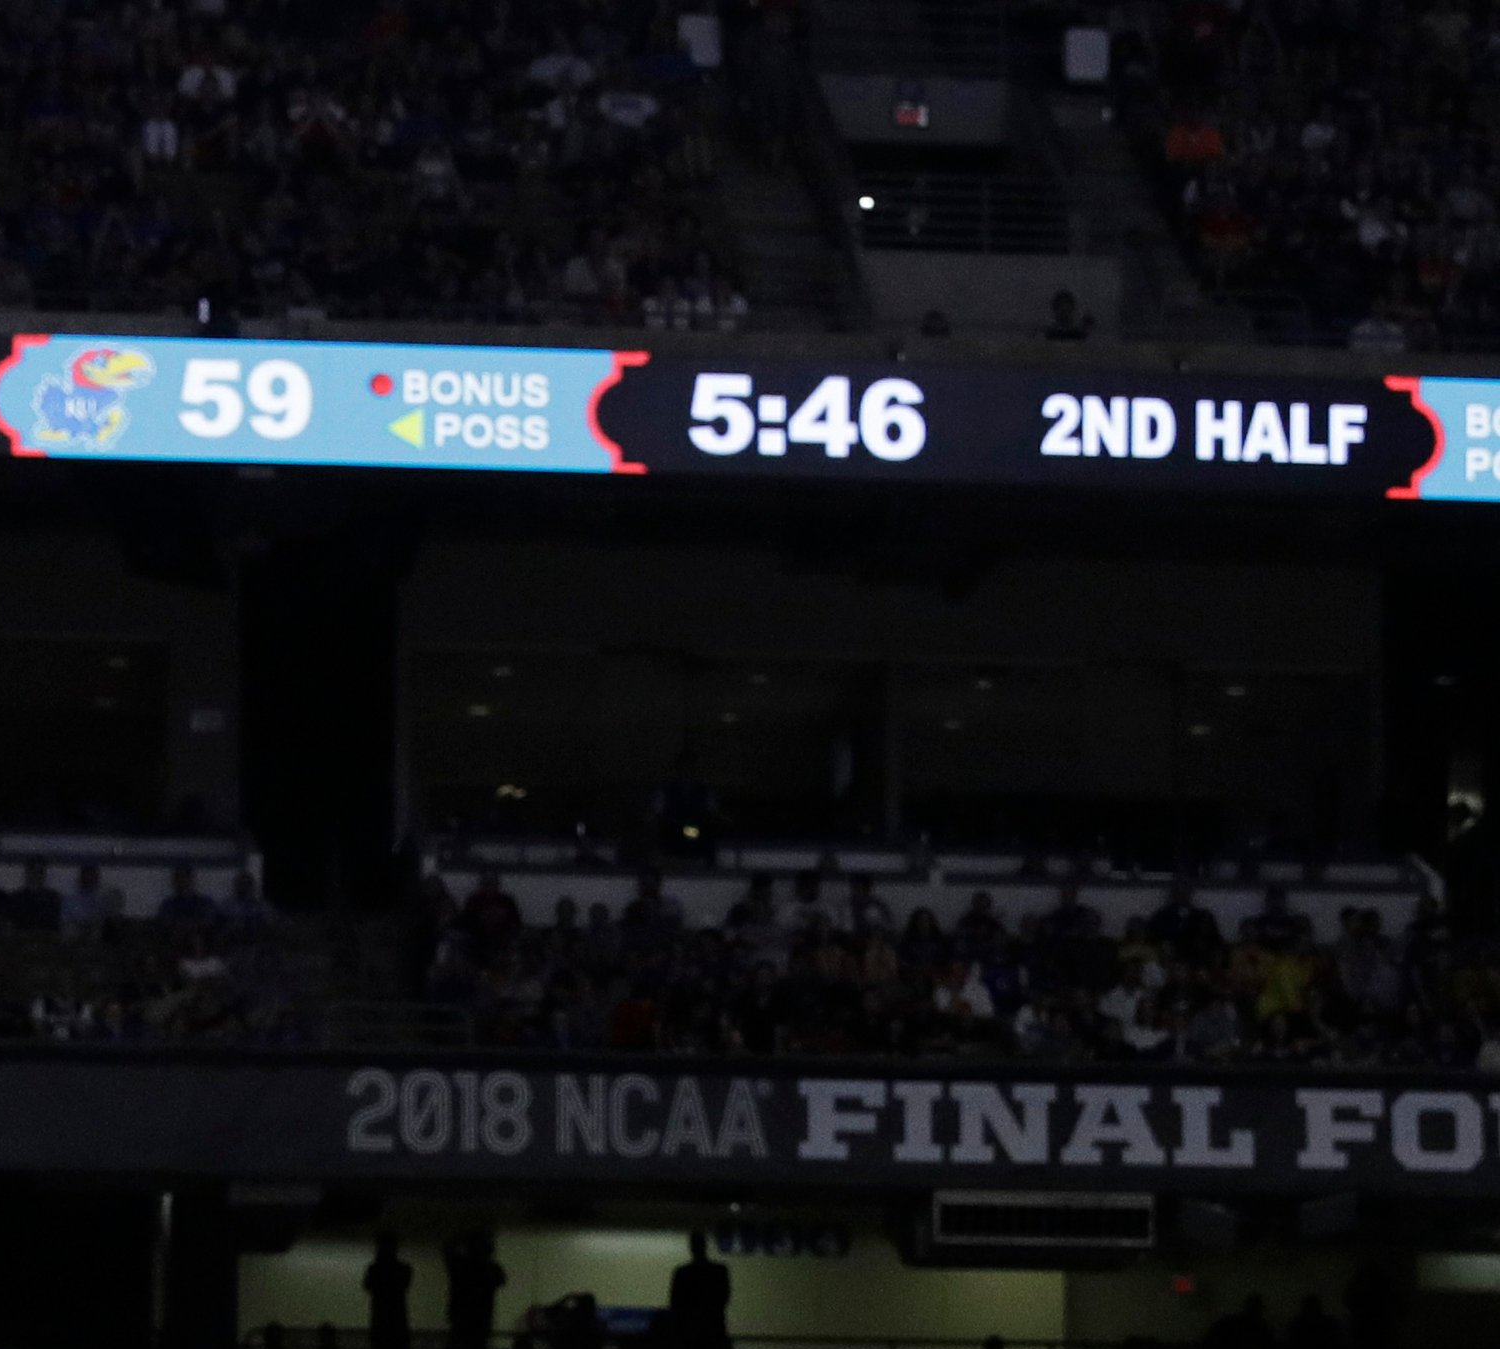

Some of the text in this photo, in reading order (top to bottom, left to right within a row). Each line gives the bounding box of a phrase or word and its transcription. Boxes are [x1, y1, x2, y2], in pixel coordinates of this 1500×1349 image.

[178, 357, 314, 440] 59
[401, 369, 551, 408] BONUS
[687, 372, 927, 461] 5:46
[434, 412, 551, 451] POSS
[1039, 393, 1368, 465] 2ND HALF
[344, 1068, 1500, 1175] 2018 NCAA FINAL FO
